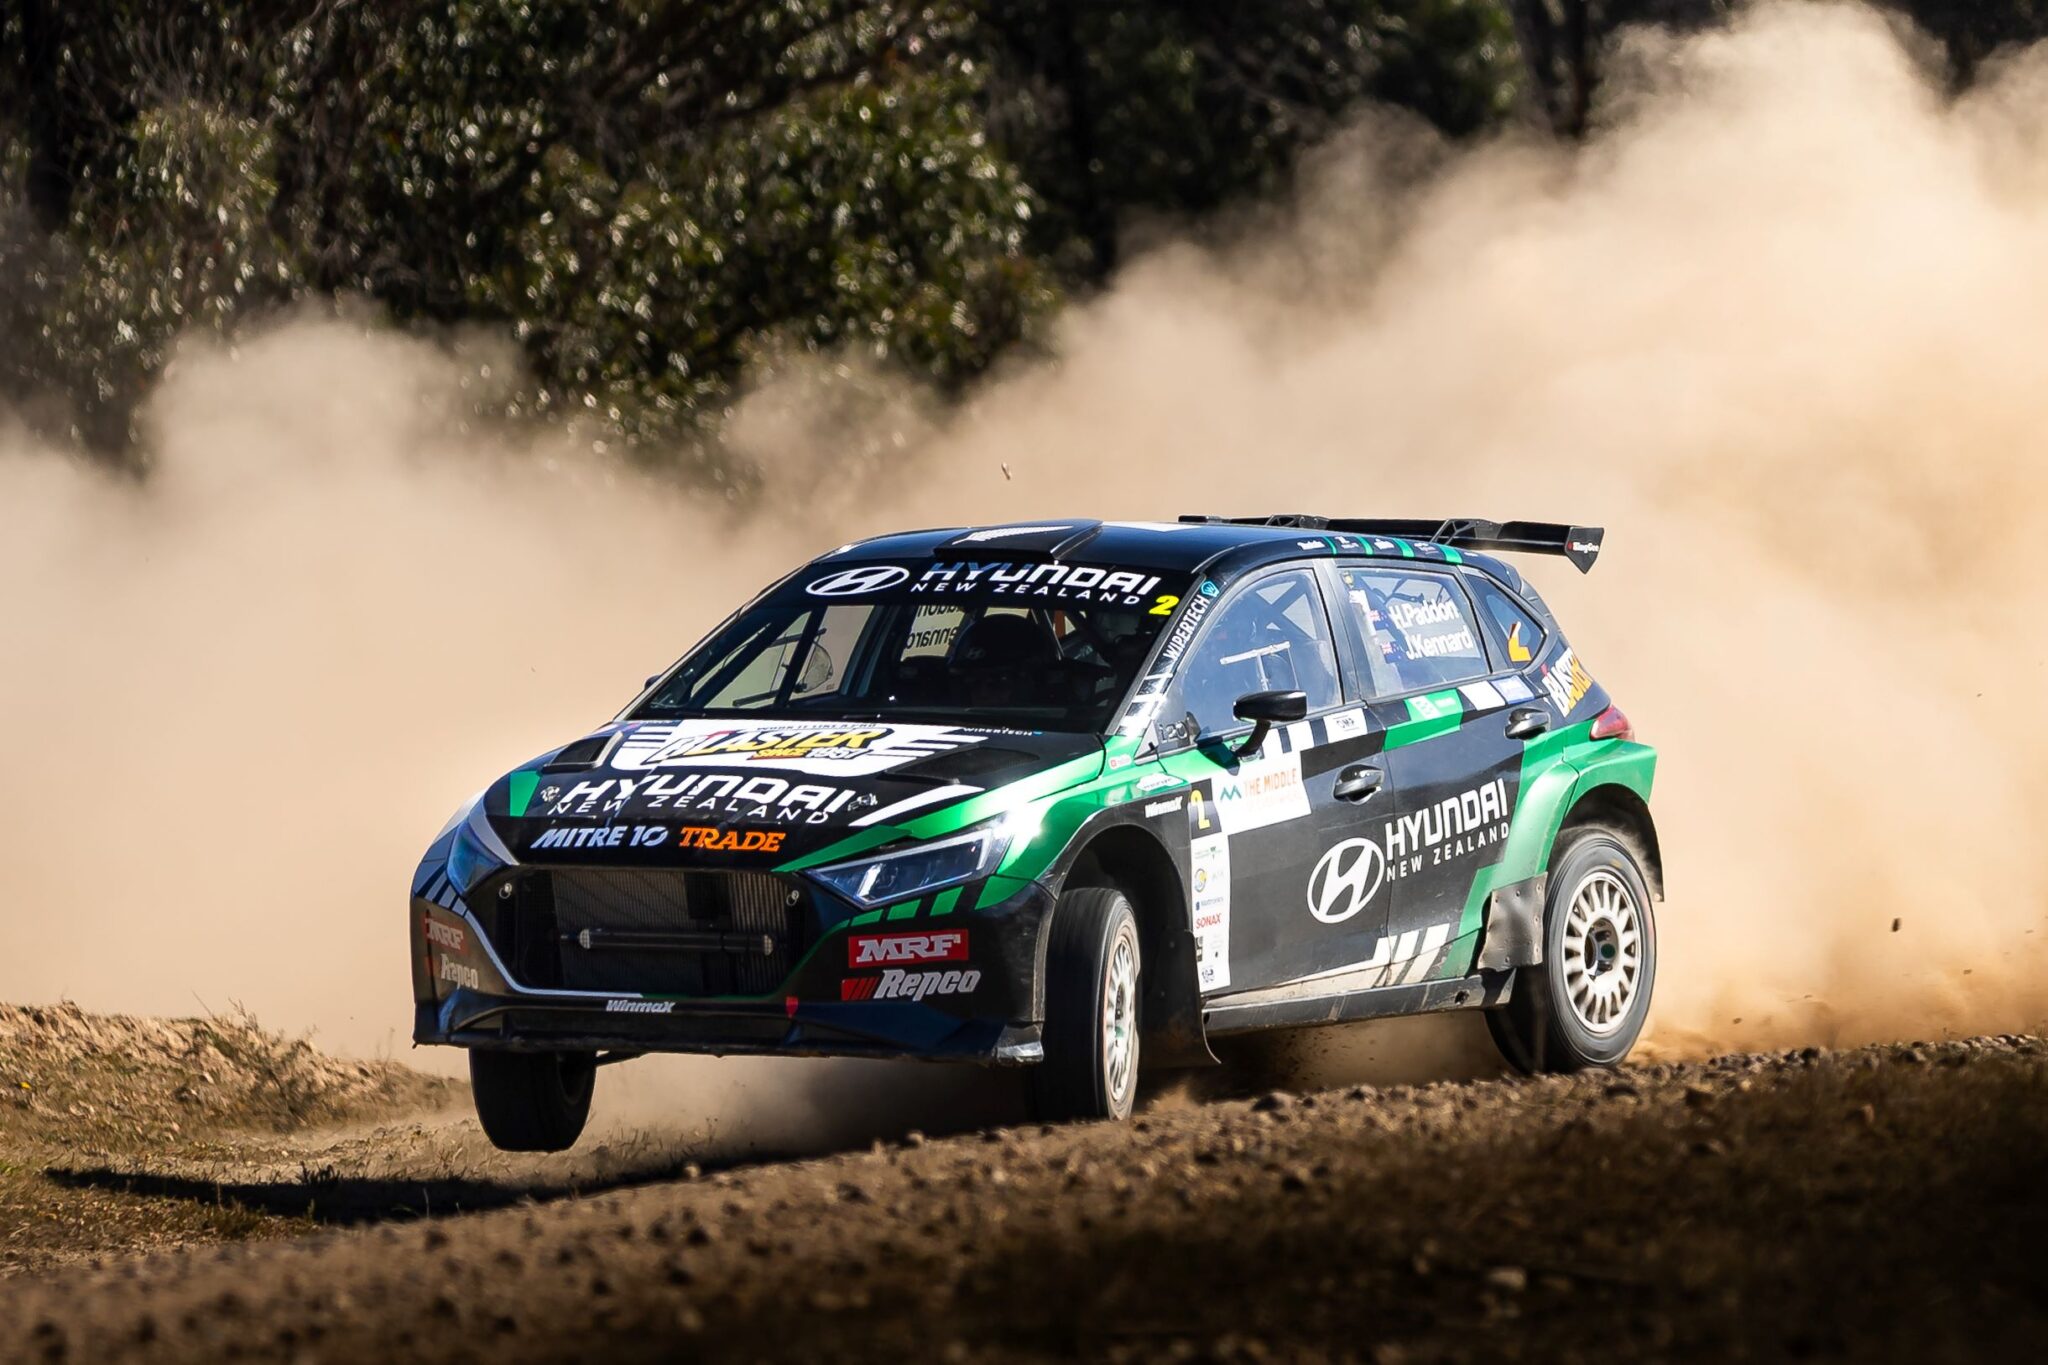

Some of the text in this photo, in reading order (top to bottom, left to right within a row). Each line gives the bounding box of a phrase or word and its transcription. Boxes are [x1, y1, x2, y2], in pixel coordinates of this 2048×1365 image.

[910, 582, 1140, 606] NEW ZEALAND
[920, 561, 1162, 595] HYUNDAI
[1148, 594, 1180, 615] 2
[1388, 599, 1460, 630] H.Paddon
[1162, 594, 1211, 661] WIPERTECH
[1405, 625, 1474, 660] J.Kennard
[752, 748, 807, 758] SINCE
[560, 774, 859, 813] HYUNDAI
[1243, 768, 1297, 797] THE MIDDLE
[547, 795, 831, 825] NEW ZEALAND
[1385, 778, 1508, 860] HYUNDAI
[530, 826, 785, 852] MITRE 10 TRADE
[1386, 822, 1510, 882] NEW ZEALAND
[425, 918, 464, 950] MRF
[856, 934, 961, 963] MRF
[440, 953, 478, 990] Repco
[873, 969, 981, 1001] Repco
